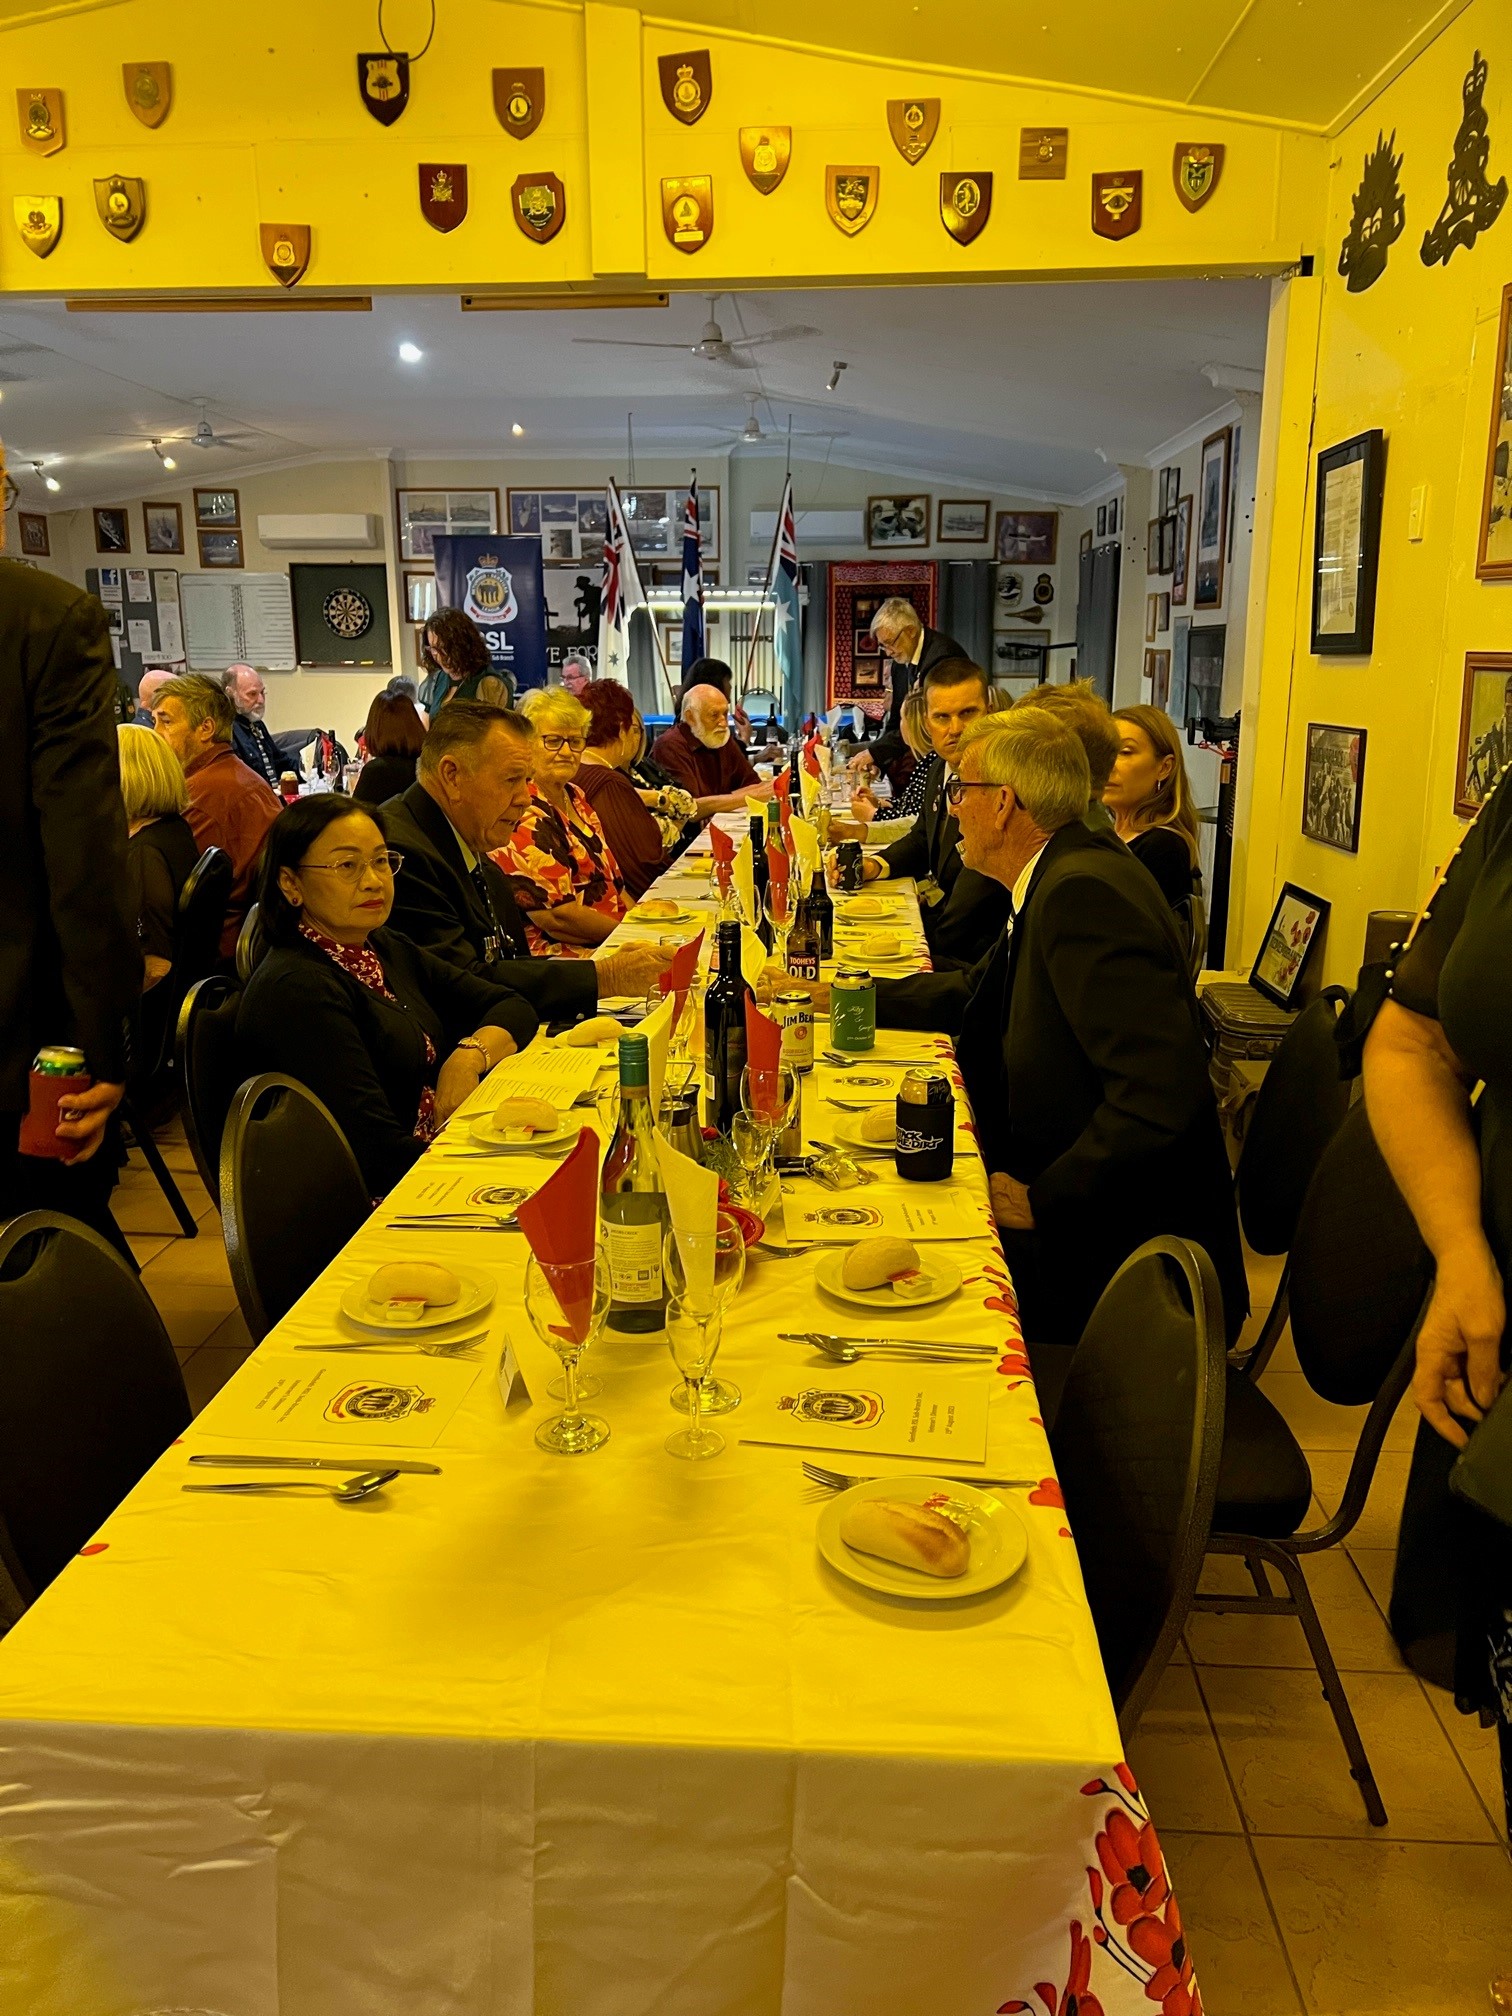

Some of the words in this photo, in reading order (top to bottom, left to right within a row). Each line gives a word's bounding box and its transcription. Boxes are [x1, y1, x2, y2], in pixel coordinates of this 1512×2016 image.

[480, 631, 514, 650] SL
[546, 647, 560, 664] E
[790, 957, 816, 965] TOOHEYS
[781, 1016, 797, 1029] JIM
[798, 1012, 814, 1024] BEA
